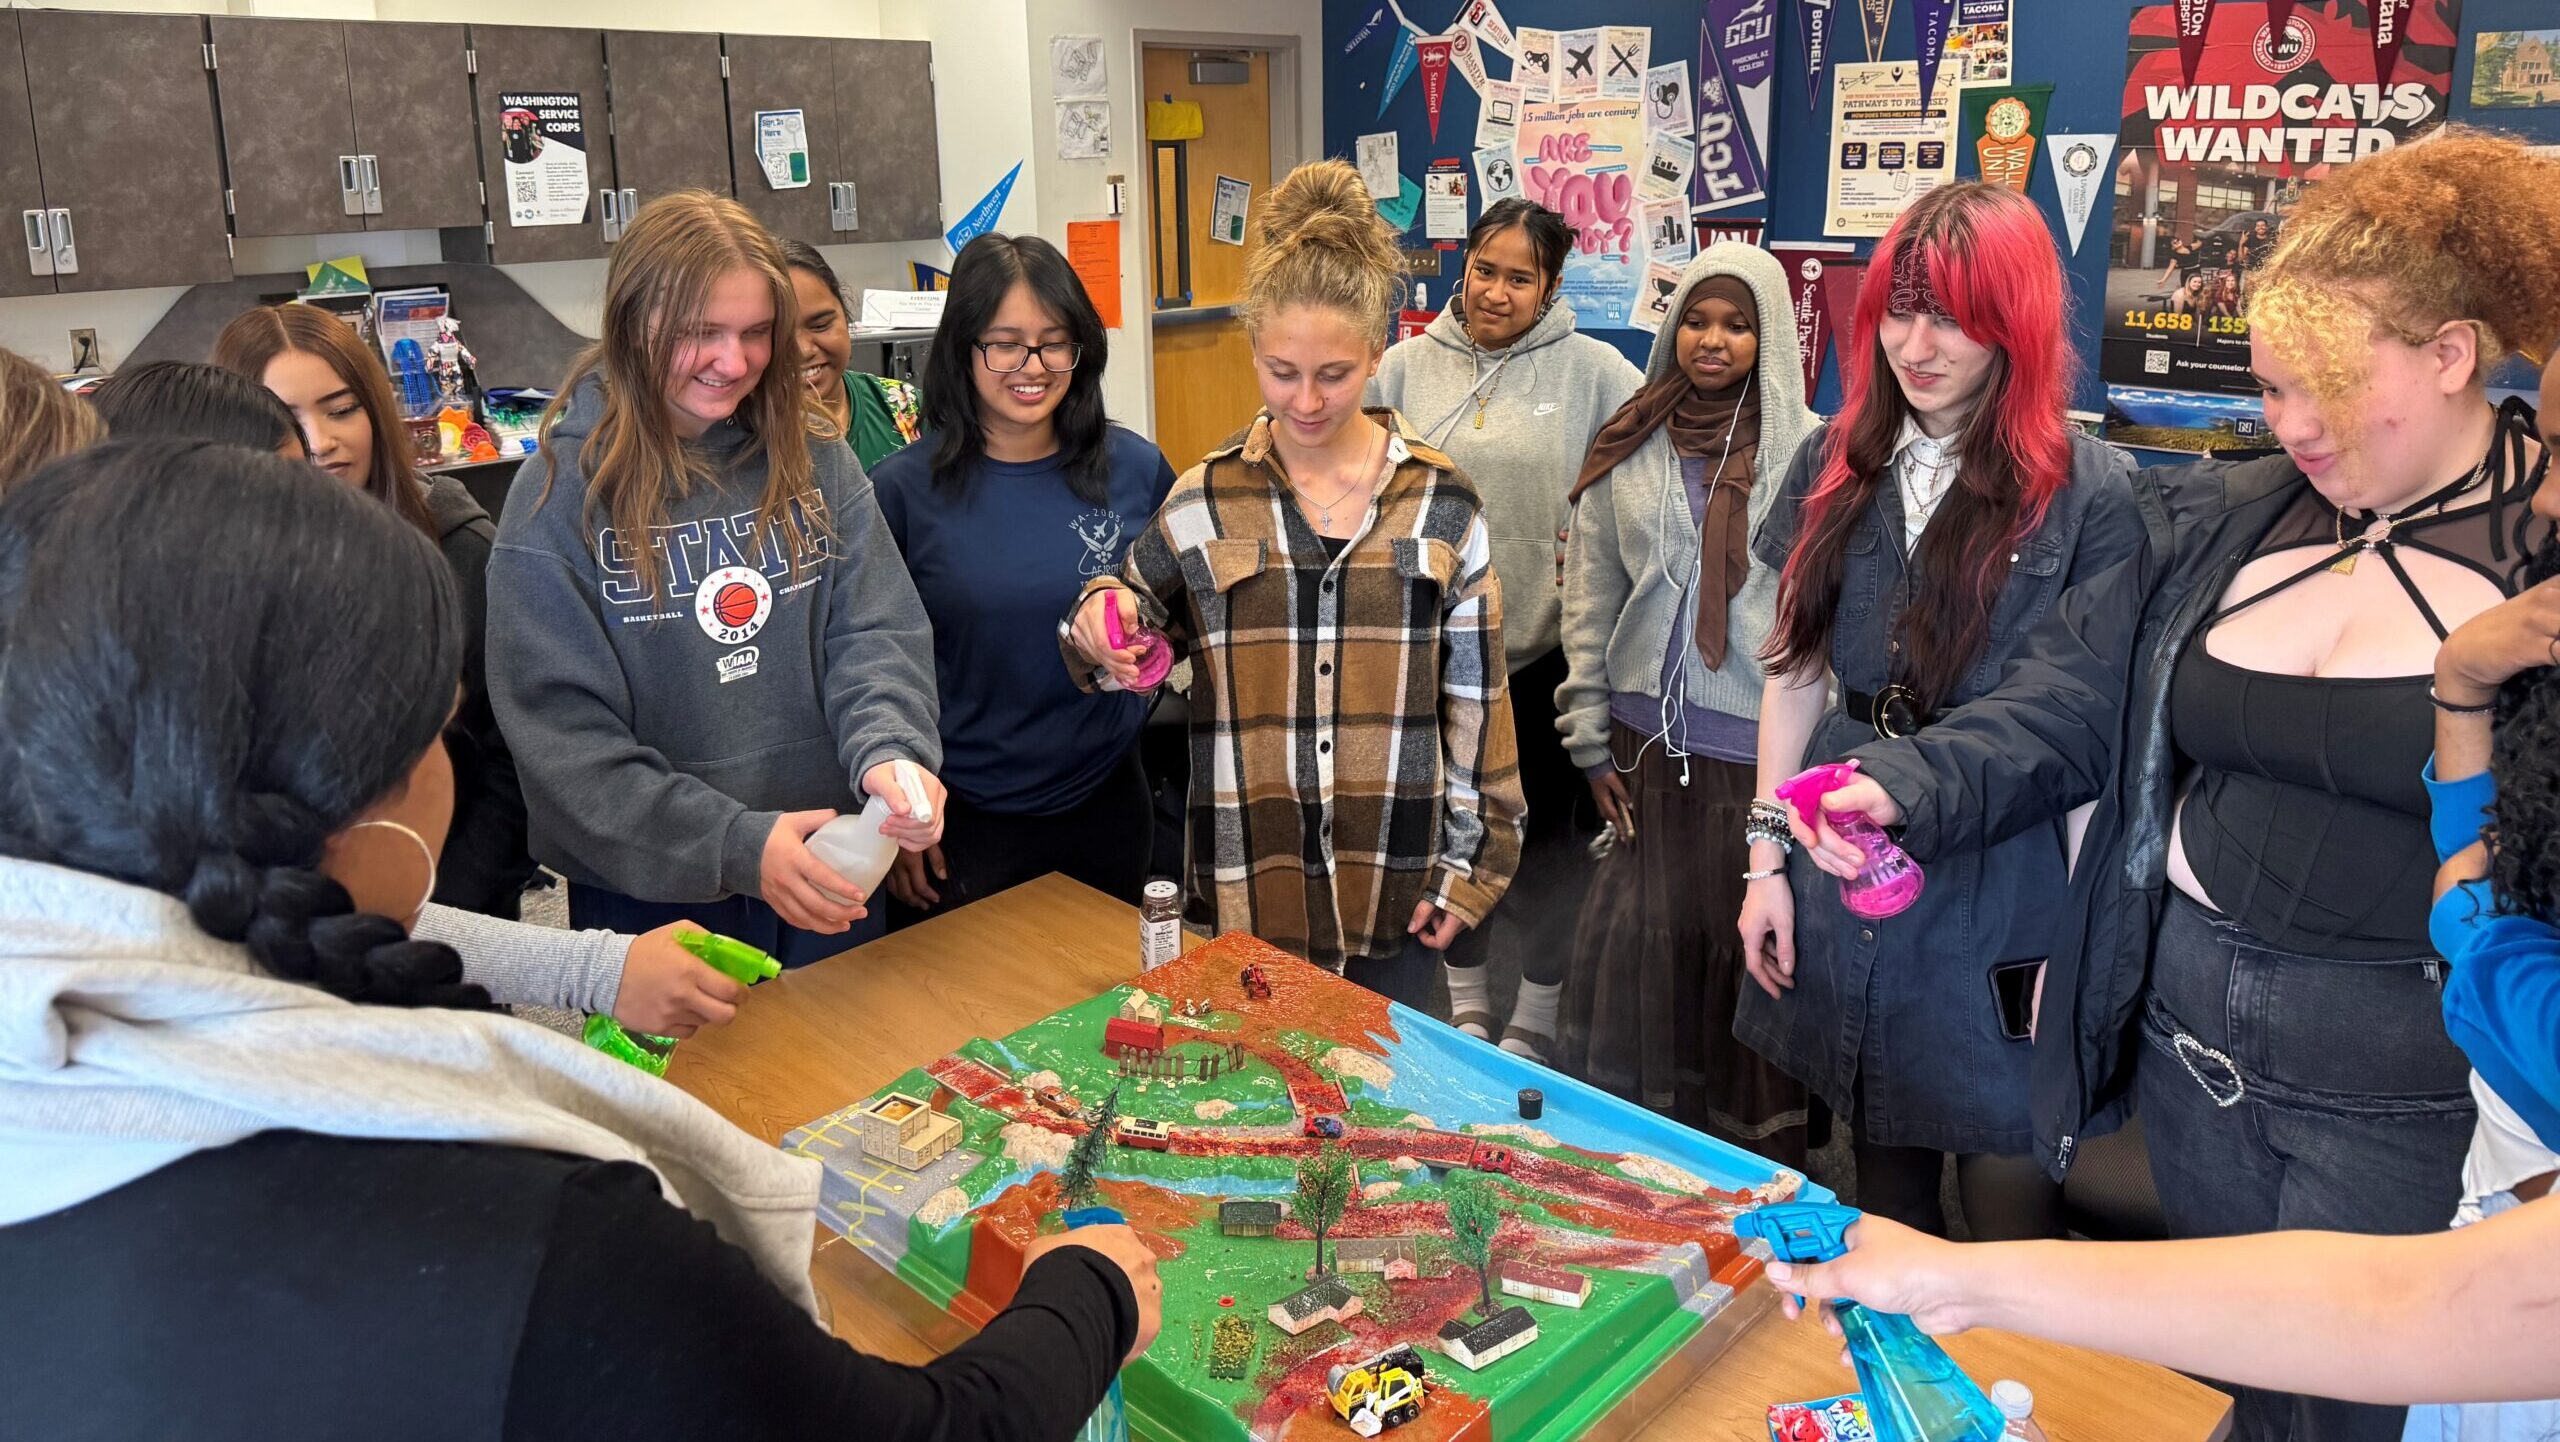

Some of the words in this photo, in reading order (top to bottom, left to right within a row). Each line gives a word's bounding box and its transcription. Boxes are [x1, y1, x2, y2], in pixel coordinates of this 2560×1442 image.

[1963, 4, 2004, 15] TACOMA
[1724, 14, 1772, 48] GCU
[1810, 9, 1823, 75] BOTHELL
[1925, 10, 1939, 67] TACOMA
[1466, 52, 1486, 86] BASTYR
[503, 96, 578, 106] WASHINGTON
[1430, 72, 1438, 114] Stanford
[1843, 99, 1888, 108] PATHWAYS
[2144, 82, 2428, 123] WILDCATS
[539, 109, 579, 119] SERVICE
[1535, 111, 1565, 122] million
[1566, 109, 1585, 124] jobs
[1604, 102, 1640, 119] coming!
[546, 122, 581, 132] CORPS
[1539, 132, 1592, 164] ARE
[1847, 145, 1862, 154] 2.7
[2161, 127, 2396, 162] WANTED
[1699, 112, 1744, 200] TCU
[1531, 166, 1632, 228] YOU
[972, 189, 1001, 231] Northwest
[1801, 283, 1816, 323] Seattle
[1607, 311, 1620, 319] WA
[2124, 310, 2193, 330] 11,658
[2190, 362, 2207, 370] your
[2208, 363, 2245, 372] counselor
[600, 489, 828, 604] STATE
[1092, 563, 1121, 577] AFJROT
[623, 611, 683, 623] BASKETBALL
[718, 621, 760, 641] 2014
[722, 652, 753, 669] WIAA
